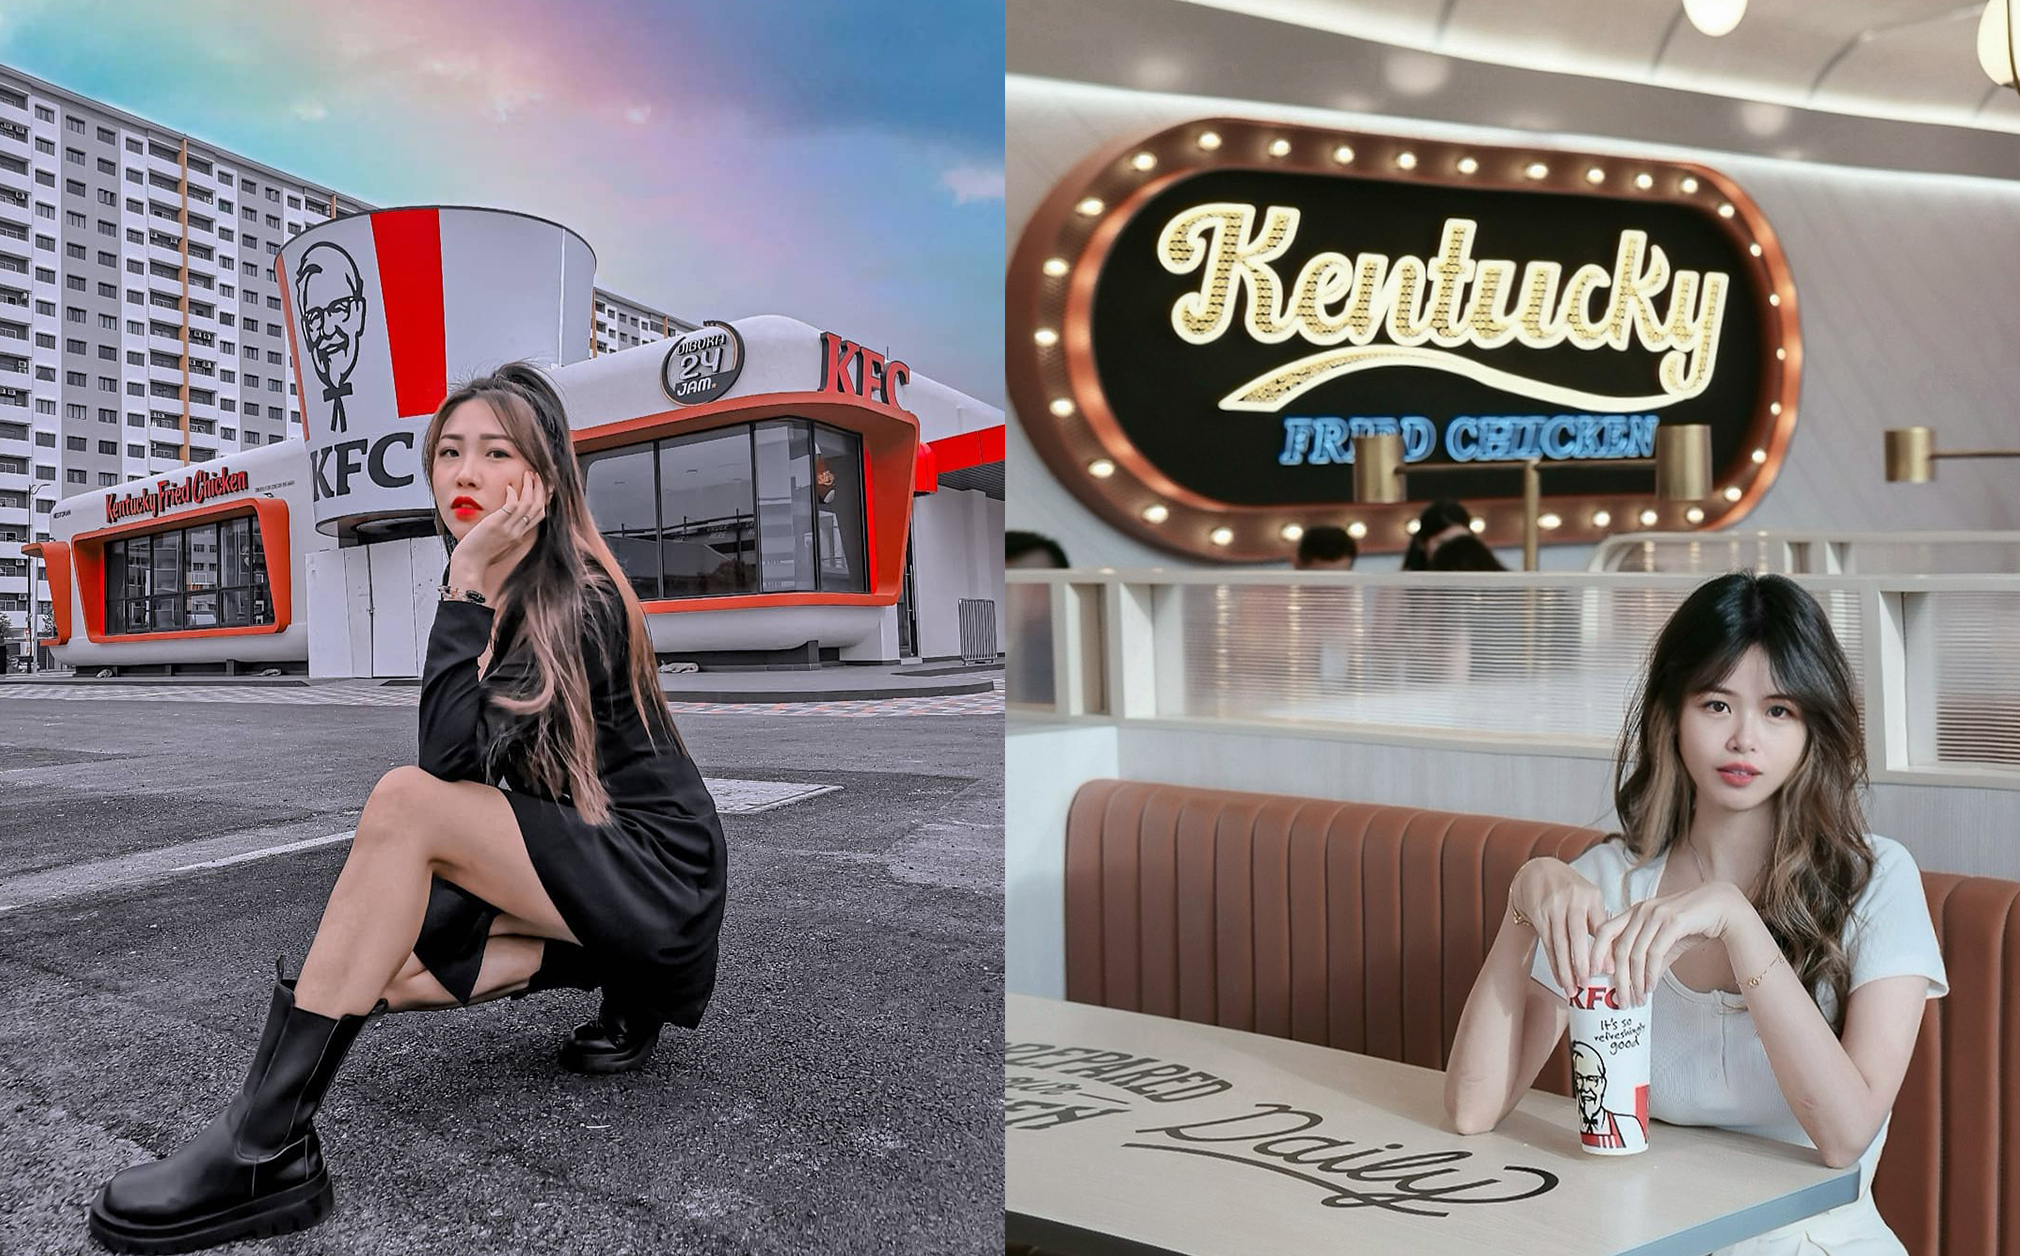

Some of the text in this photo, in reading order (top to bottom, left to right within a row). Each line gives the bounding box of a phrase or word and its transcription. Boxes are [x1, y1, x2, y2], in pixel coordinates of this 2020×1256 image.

[1157, 203, 1730, 398] Kentucky
[677, 334, 726, 355] DIBUKA
[680, 347, 723, 381] 24
[817, 331, 910, 412] KFC
[1444, 414, 1660, 462] CHICKEN
[310, 432, 415, 502] KFC
[105, 467, 249, 524] Kentucky Fried Chicken
[1600, 1017, 1632, 1030] It's so
[1609, 1035, 1640, 1056] good
[1132, 1102, 1560, 1217] Daily
